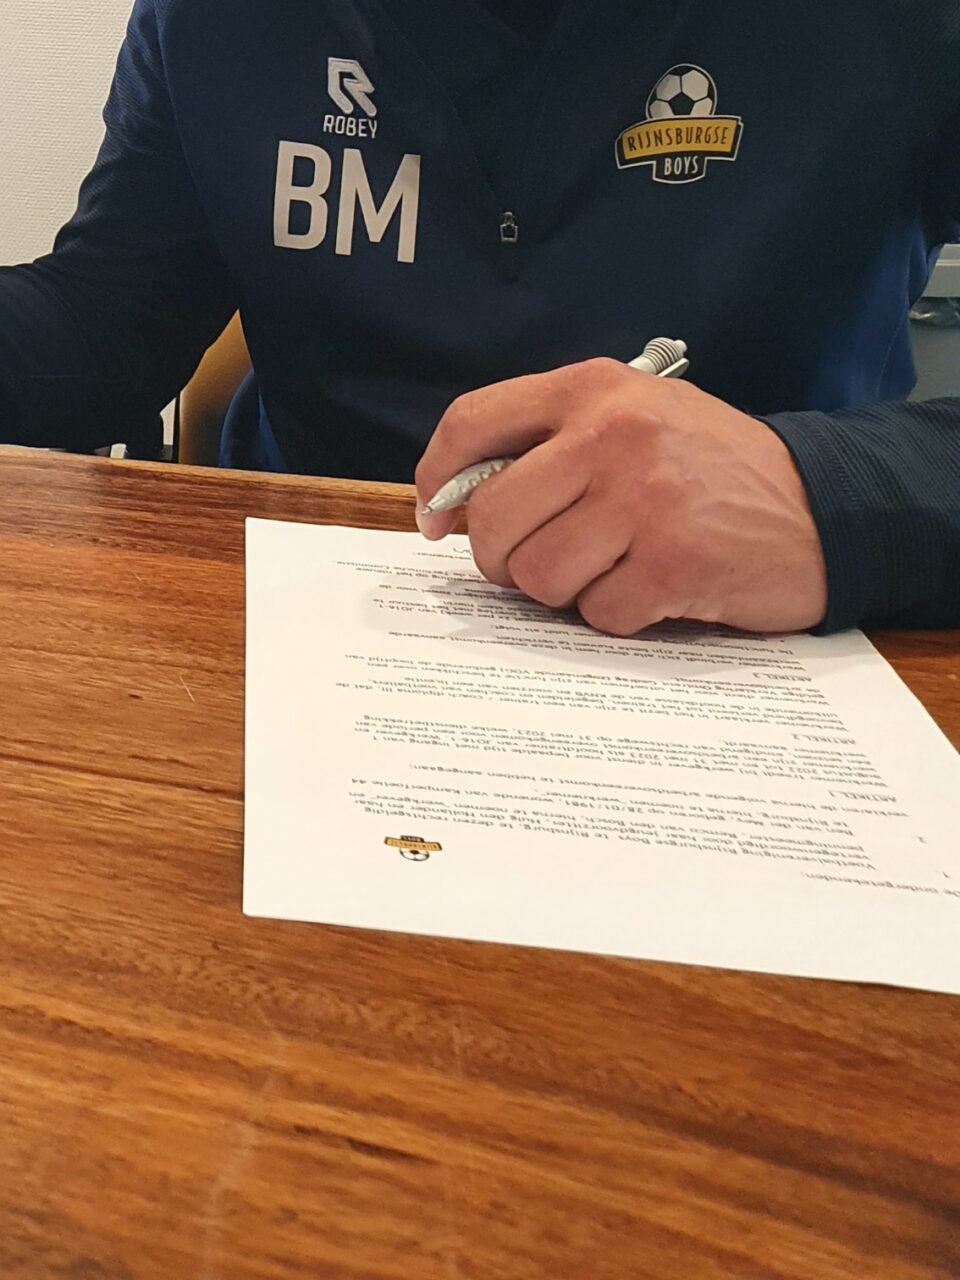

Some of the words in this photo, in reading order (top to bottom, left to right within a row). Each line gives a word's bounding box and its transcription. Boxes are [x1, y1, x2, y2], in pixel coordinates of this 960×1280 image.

[323, 114, 378, 139] ROBEY
[626, 126, 729, 152] RIJNSBURGSE
[663, 155, 699, 176] BOYS
[273, 140, 421, 264] BM
